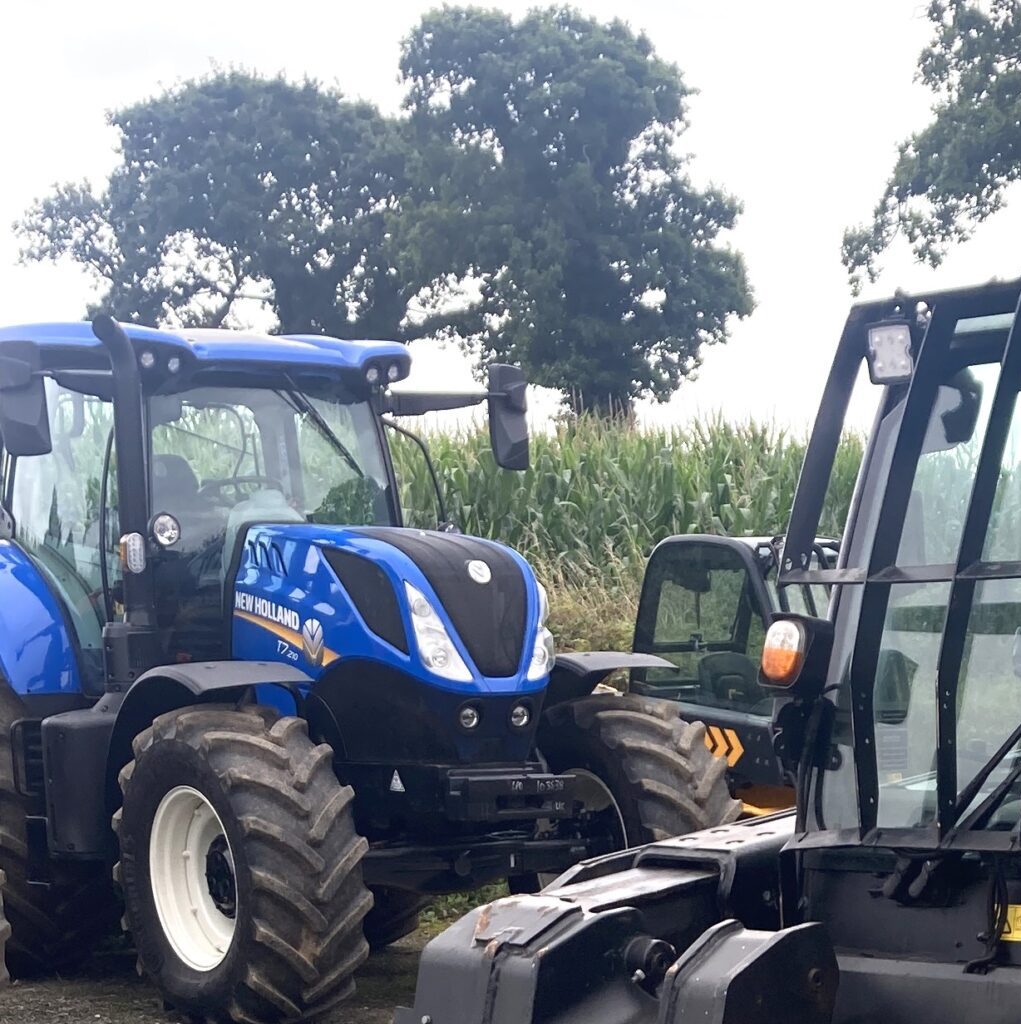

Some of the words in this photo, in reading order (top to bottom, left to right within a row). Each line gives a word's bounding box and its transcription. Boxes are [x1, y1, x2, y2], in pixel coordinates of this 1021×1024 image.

[235, 591, 254, 612] NEW
[255, 597, 300, 631] HOLLAND
[277, 640, 288, 654] T7
